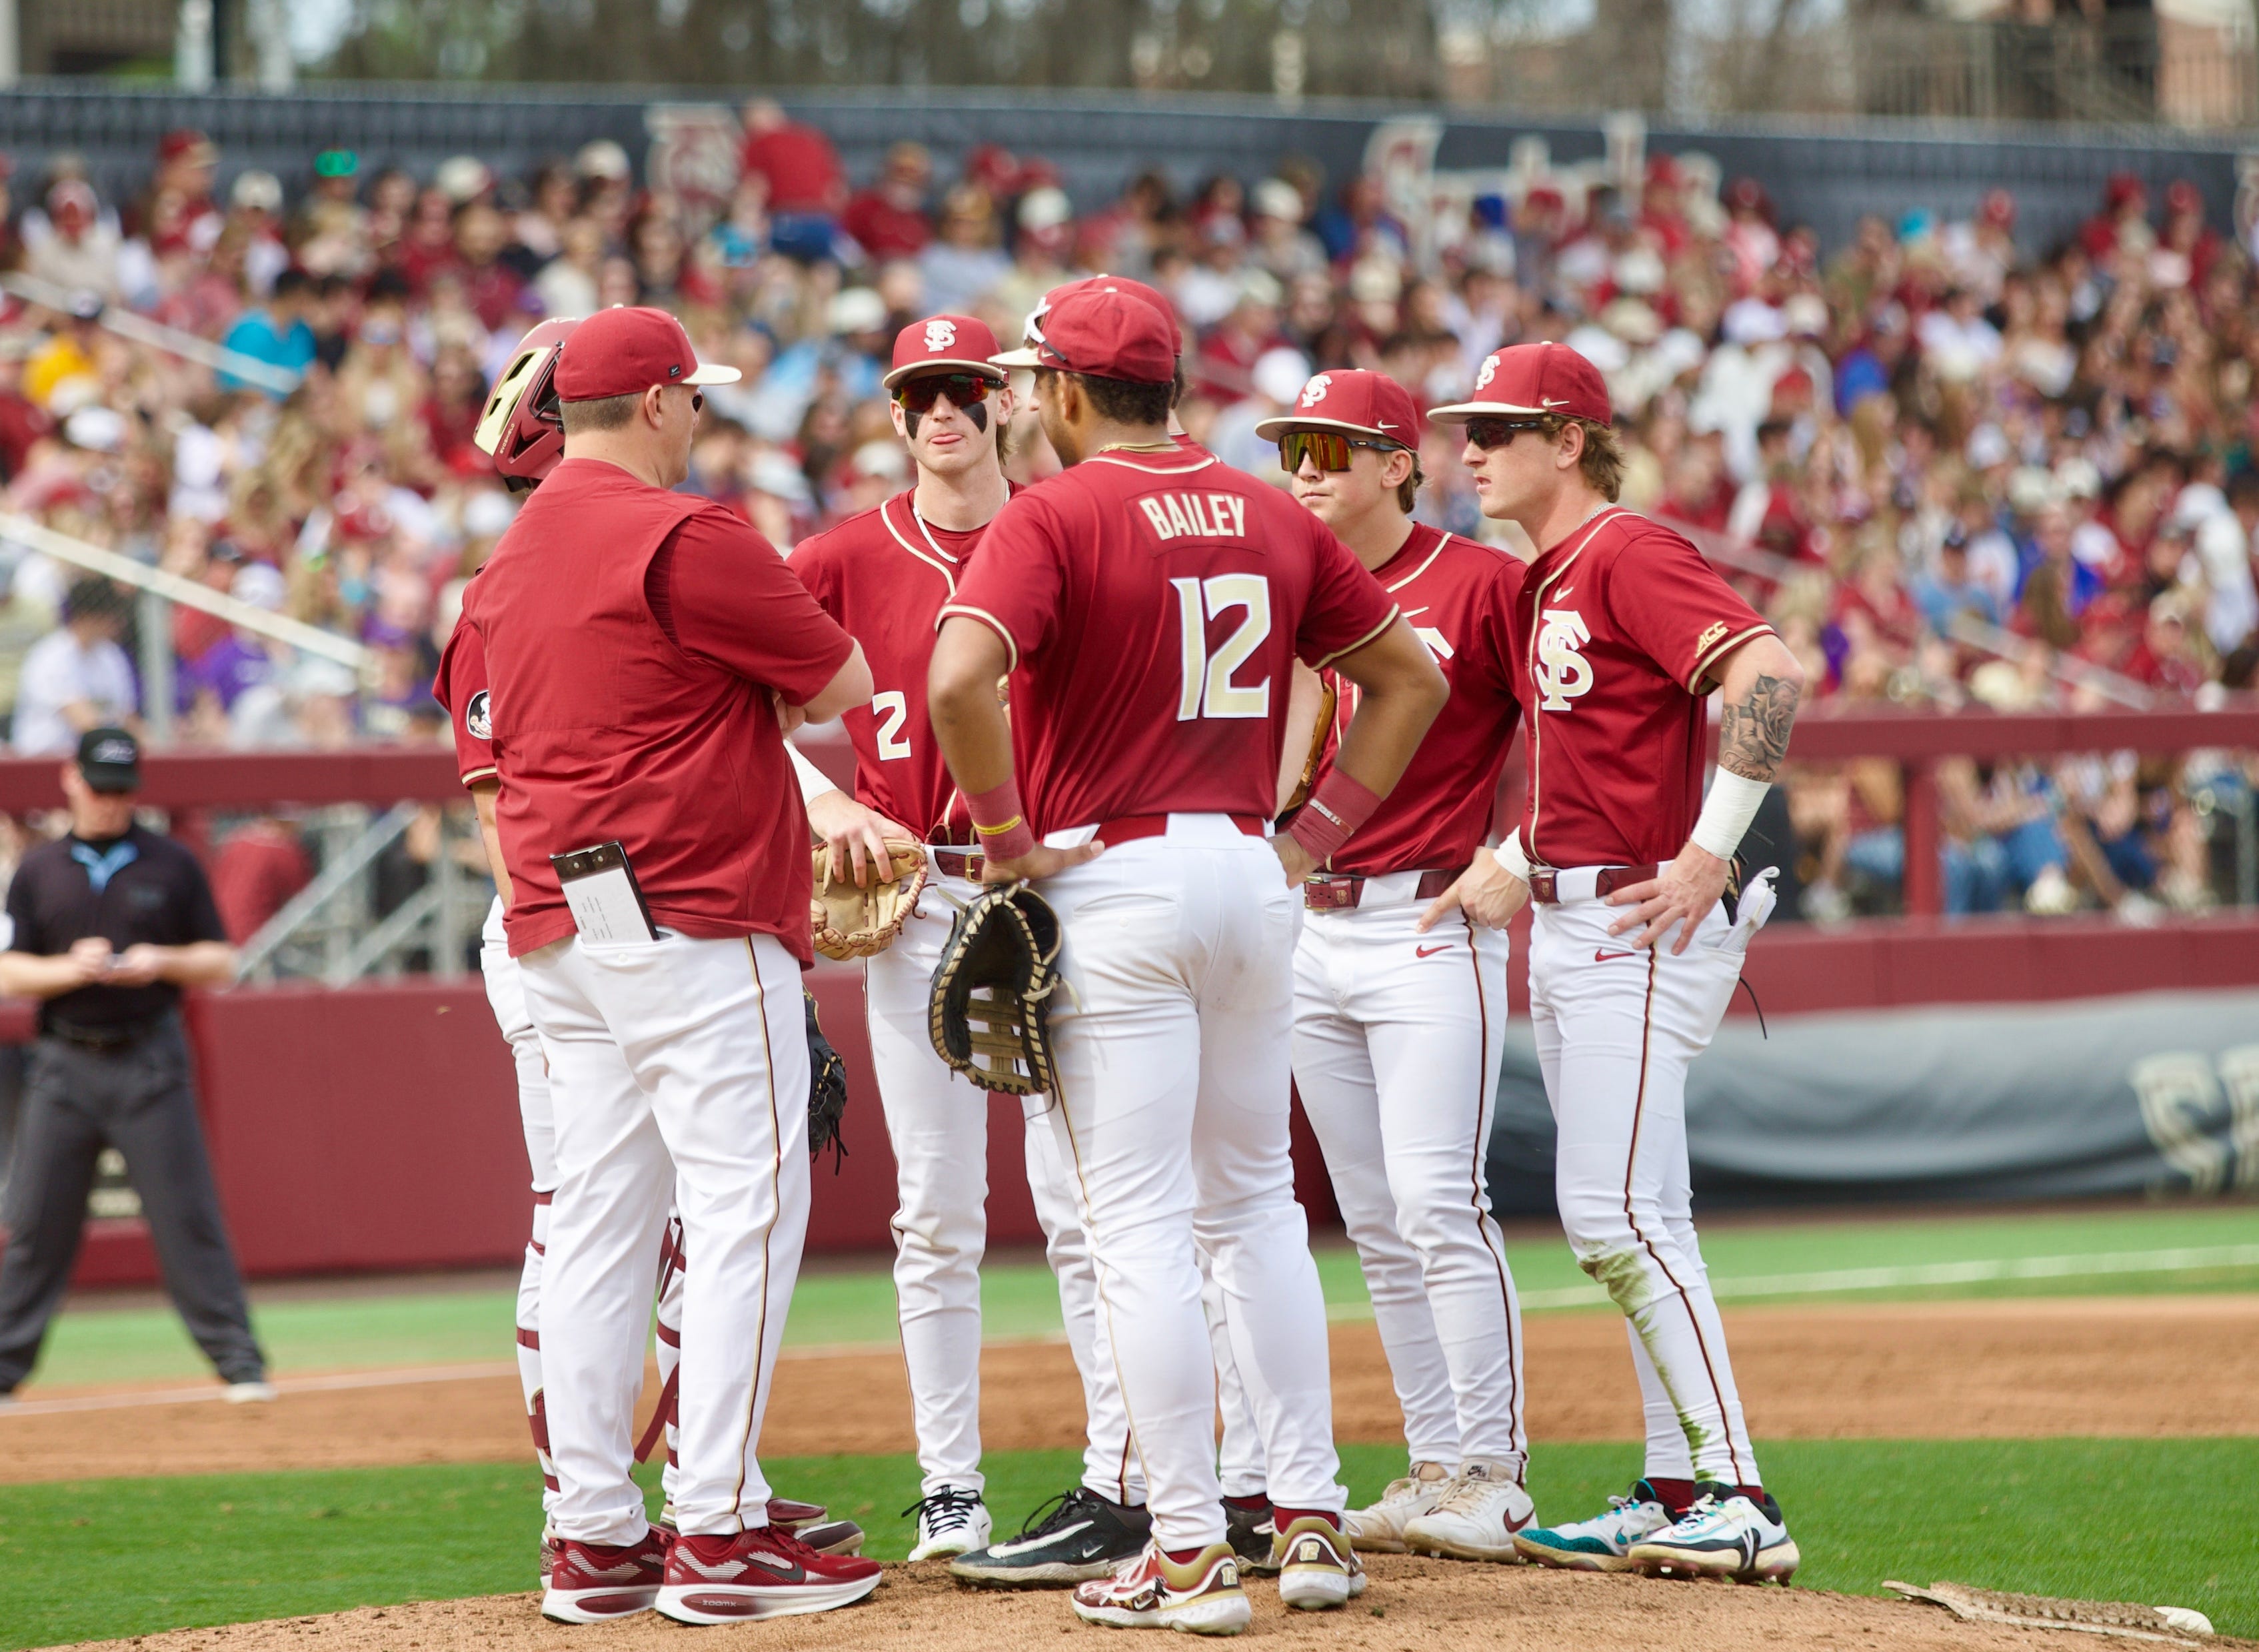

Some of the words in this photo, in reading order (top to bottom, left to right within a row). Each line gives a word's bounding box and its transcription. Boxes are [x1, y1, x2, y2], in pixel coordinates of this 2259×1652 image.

[1138, 493, 1245, 540] BAILEY
[1168, 572, 1271, 722] 12
[1695, 620, 1728, 659] ACC
[872, 690, 912, 761] 2
